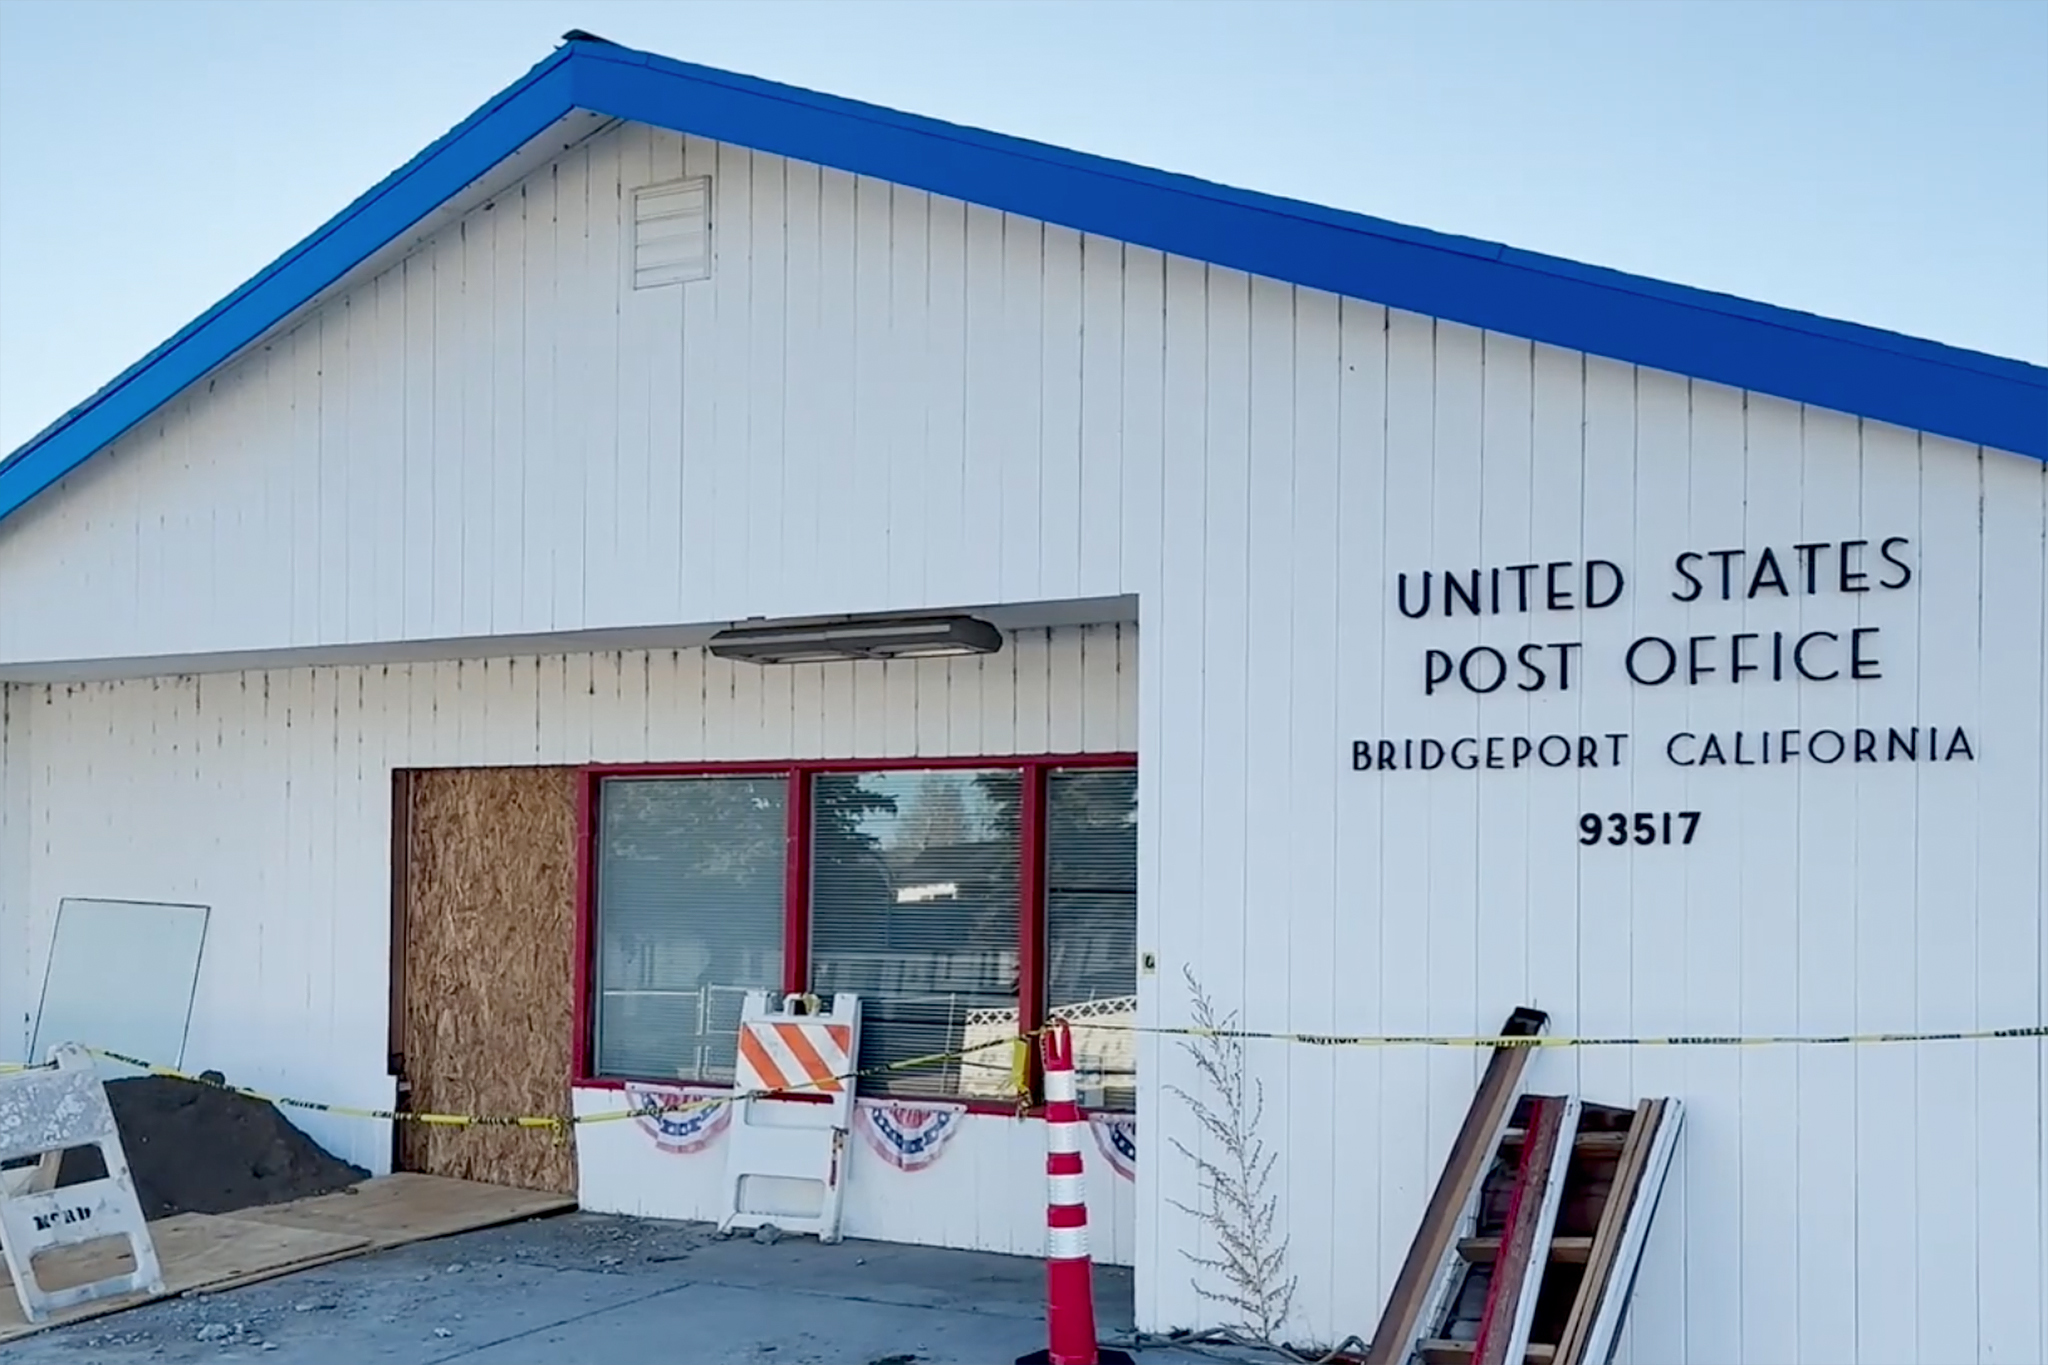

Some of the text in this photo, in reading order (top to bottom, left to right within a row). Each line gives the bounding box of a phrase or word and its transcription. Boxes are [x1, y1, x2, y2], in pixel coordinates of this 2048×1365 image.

[1398, 537, 1912, 619] UNITED STATES
[1425, 627, 1882, 696] POST OFFICE
[1353, 726, 1974, 771] BRIDGEPORT CALIFORNIA
[1579, 811, 1702, 846] 93517
